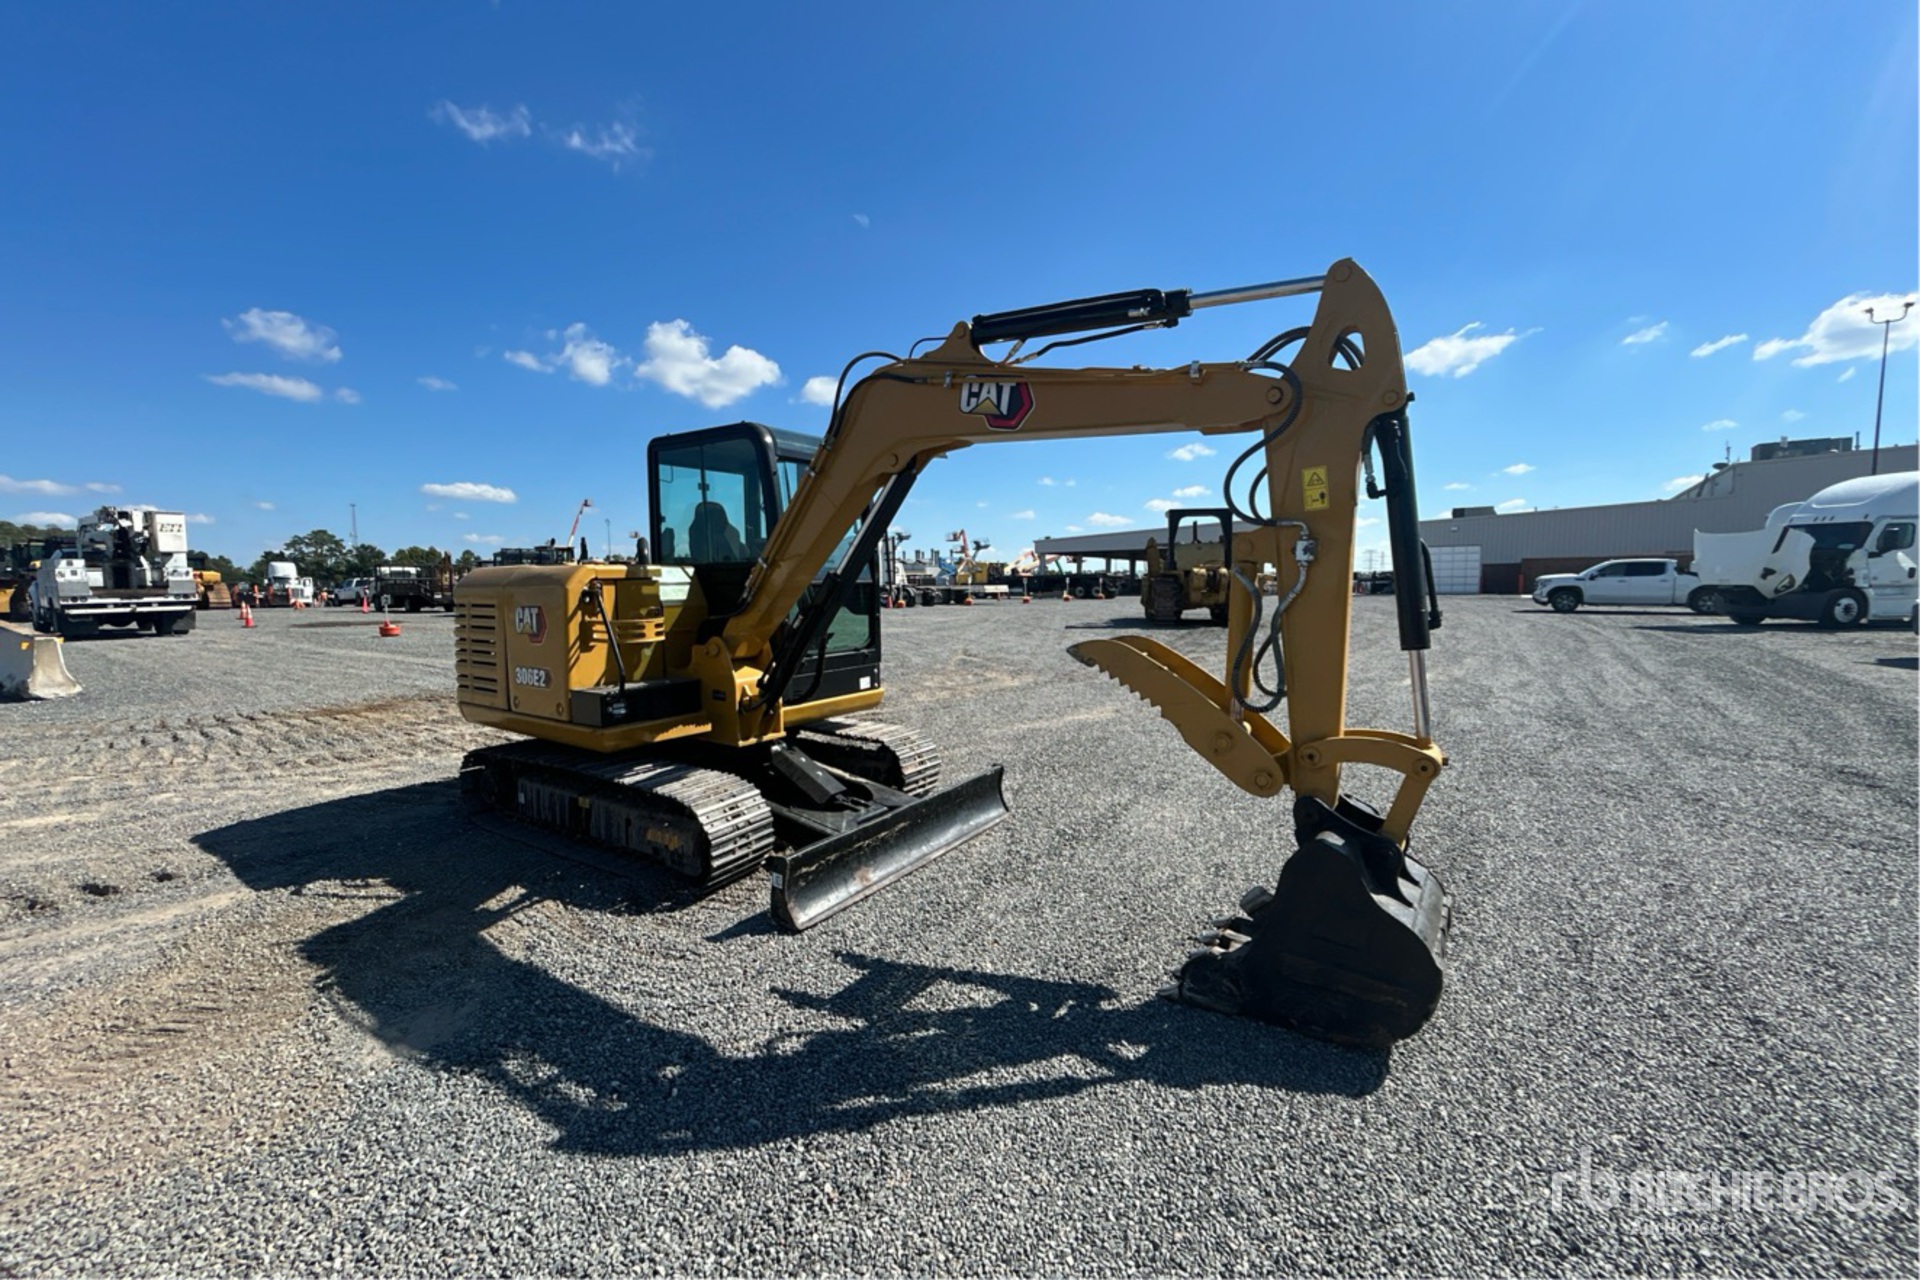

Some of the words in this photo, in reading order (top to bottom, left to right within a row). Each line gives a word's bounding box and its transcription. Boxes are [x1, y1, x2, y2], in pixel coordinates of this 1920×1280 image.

[960, 376, 1017, 416] CAT
[515, 607, 539, 633] CAT
[515, 667, 546, 687] 306E2
